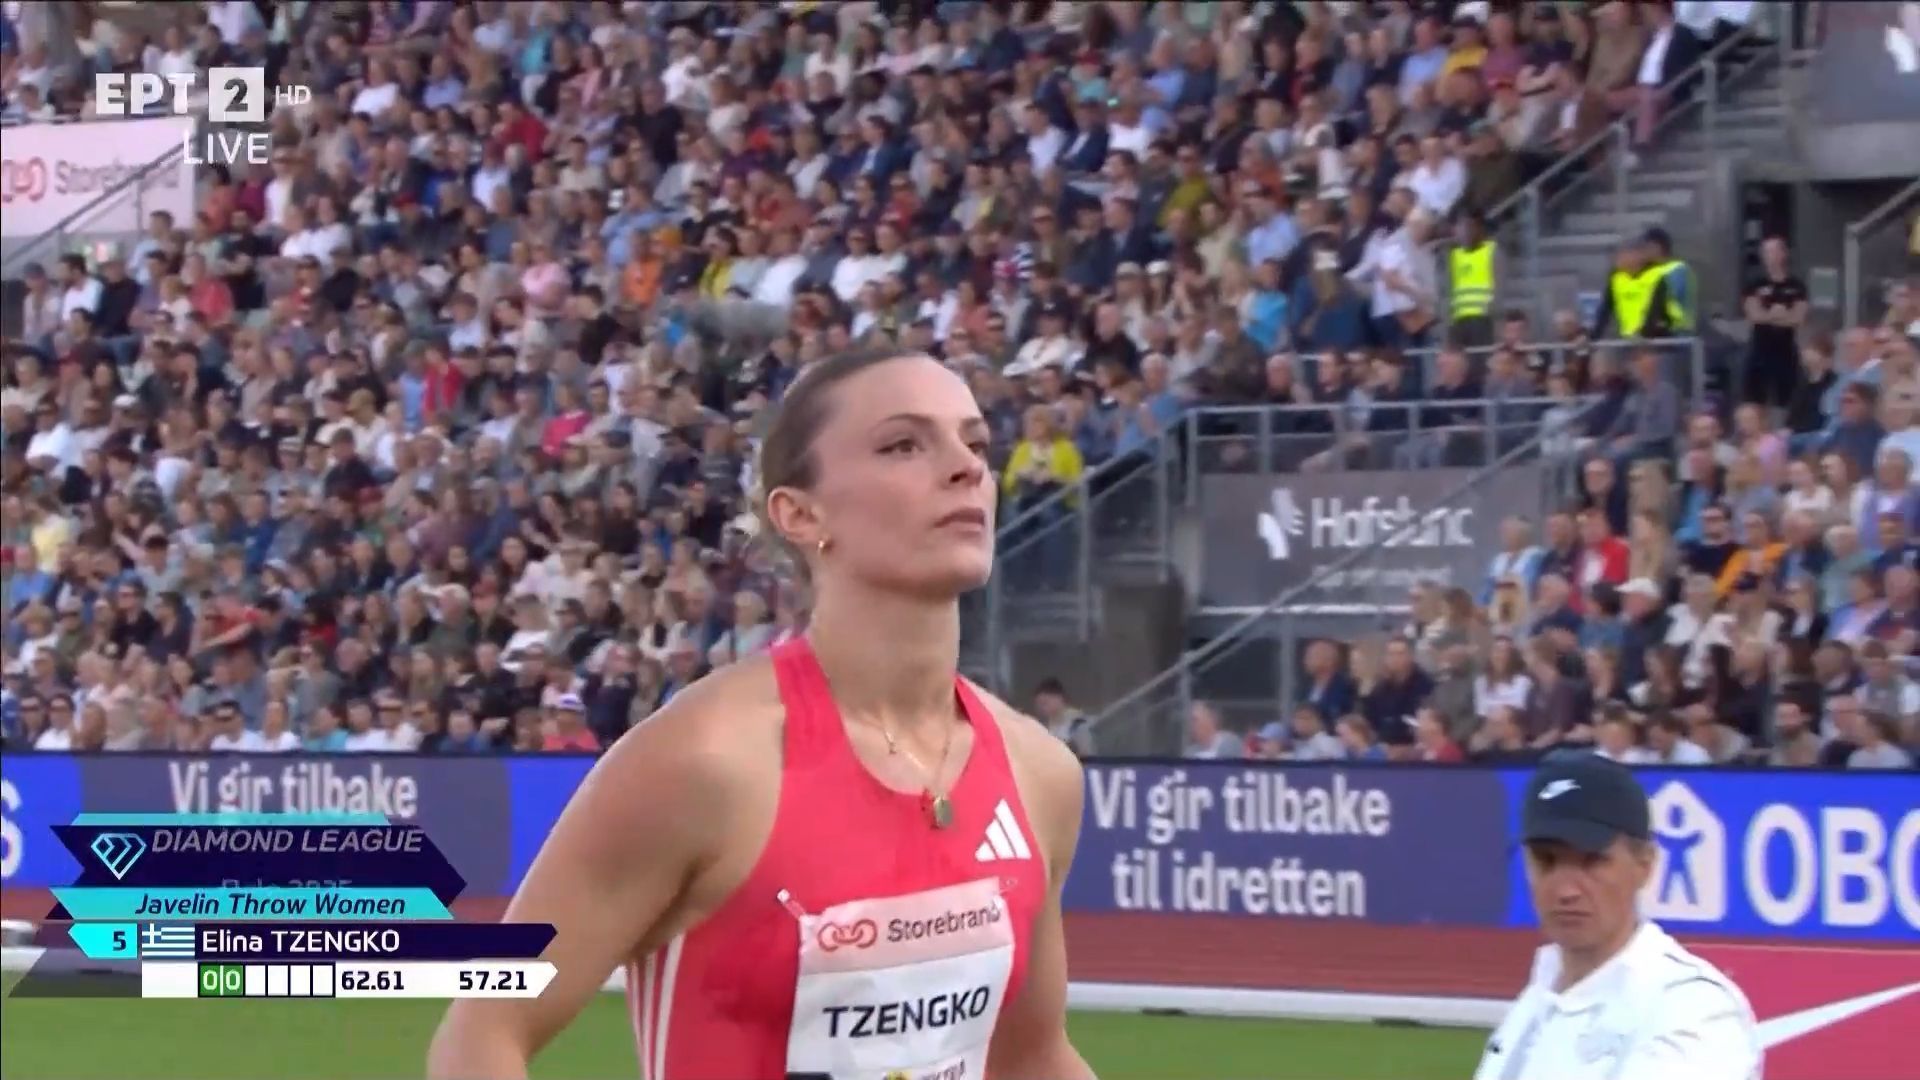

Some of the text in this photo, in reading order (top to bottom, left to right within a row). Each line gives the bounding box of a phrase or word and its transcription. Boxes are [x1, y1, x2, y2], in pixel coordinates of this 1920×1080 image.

[168, 761, 209, 814] Vi
[280, 761, 418, 818] tilbake
[1087, 767, 1392, 845] Vi gir tilbake
[1111, 847, 1367, 918] til idretten
[887, 898, 1001, 943] Storebrand
[822, 985, 990, 1039] TZENGKO
